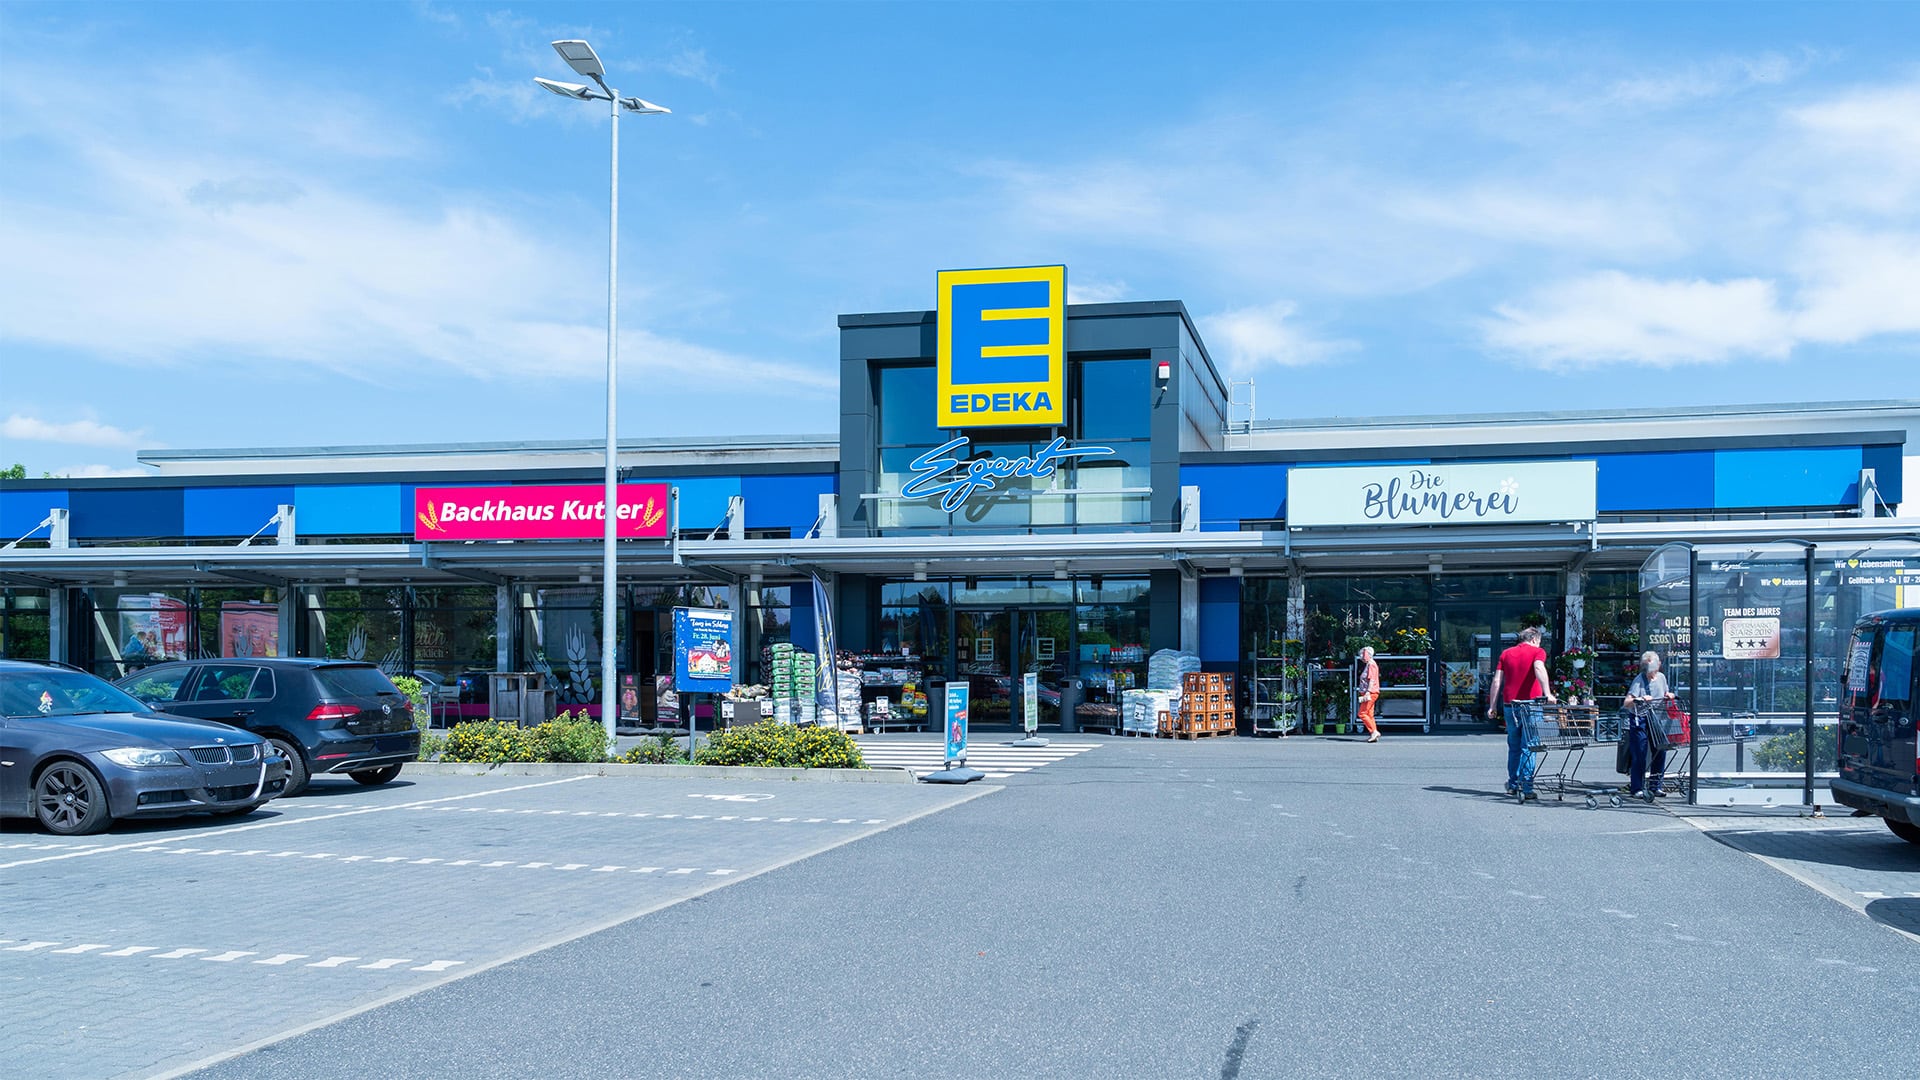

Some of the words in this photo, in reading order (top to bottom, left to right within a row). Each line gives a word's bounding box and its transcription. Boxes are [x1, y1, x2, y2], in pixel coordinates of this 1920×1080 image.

[951, 280, 1050, 385] E
[951, 391, 1053, 413] EDEKA
[902, 436, 1116, 512] Egert
[1409, 469, 1444, 490] Die
[1362, 476, 1519, 520] Blumerei
[440, 500, 554, 522] Backhaus
[561, 500, 643, 521] Kuter
[1834, 560, 1847, 569] Wir
[1782, 578, 1821, 586] Lebensmel.
[1723, 608, 1742, 617] TEAM
[1742, 607, 1756, 616] DES
[1756, 607, 1781, 616] JAHRES
